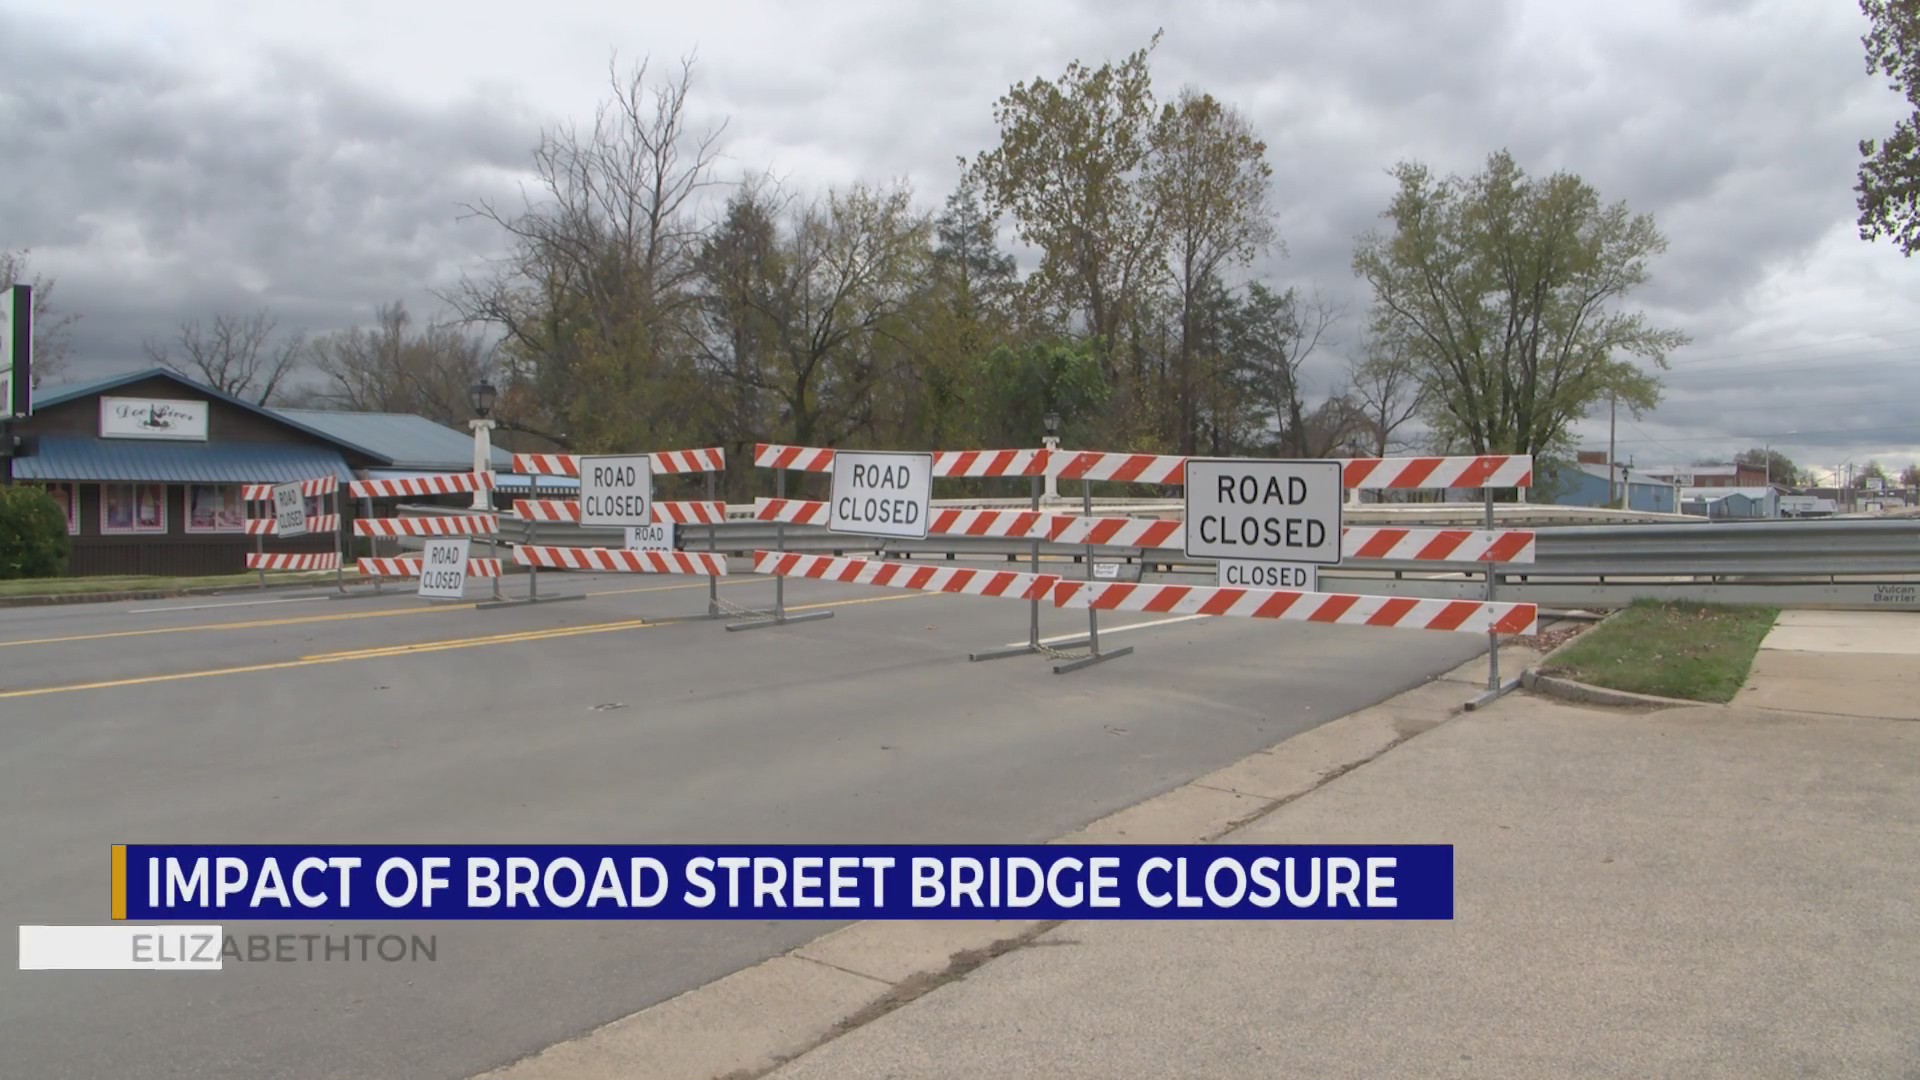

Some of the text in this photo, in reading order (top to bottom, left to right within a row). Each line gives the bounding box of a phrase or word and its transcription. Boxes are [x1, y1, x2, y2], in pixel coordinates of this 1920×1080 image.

[594, 466, 636, 487] ROAD
[852, 463, 910, 490] ROAD
[279, 489, 297, 506] ROAD
[1218, 475, 1307, 505] ROAD
[586, 495, 644, 517] CLOSED
[839, 496, 919, 525] CLOSED
[280, 510, 304, 529] CLOSED
[635, 527, 664, 541] ROAD
[1200, 515, 1326, 548] CLOSED
[431, 546, 459, 565] ROAD
[423, 570, 461, 590] CLOSED
[1227, 565, 1307, 587] CLOSED
[1873, 593, 1917, 602] Barrier
[1876, 584, 1915, 594] Vulcan
